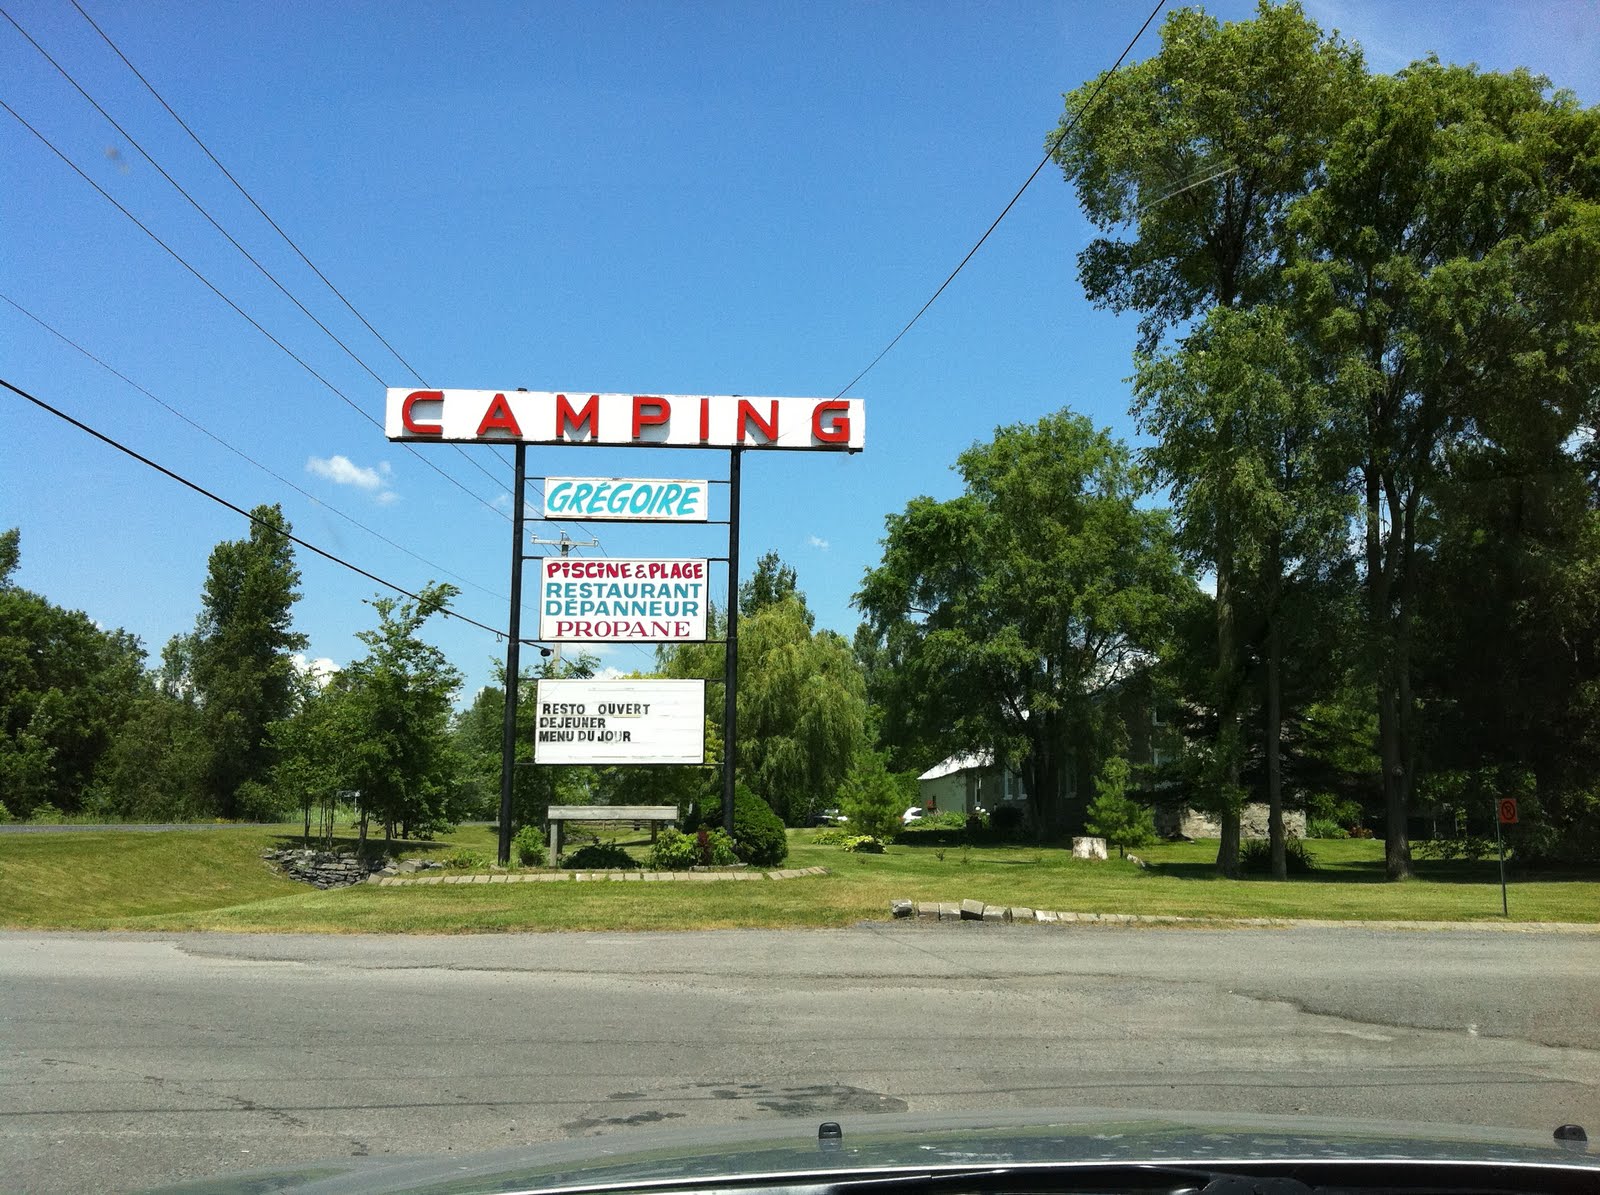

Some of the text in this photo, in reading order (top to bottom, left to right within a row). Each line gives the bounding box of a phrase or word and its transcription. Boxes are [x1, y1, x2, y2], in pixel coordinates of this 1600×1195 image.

[402, 391, 850, 442] CAMPING
[547, 482, 700, 516] GRÉGOIRE
[635, 564, 647, 579] &
[648, 563, 703, 579] PLAGE
[546, 583, 702, 599] RESTAURANT
[545, 599, 698, 617] DÉPANNEUR
[556, 621, 690, 637] PROPANE
[542, 703, 650, 715] RESTO OUVERT
[539, 717, 606, 728] DEJEUNER
[539, 731, 574, 742] MENU
[577, 731, 595, 742] DU
